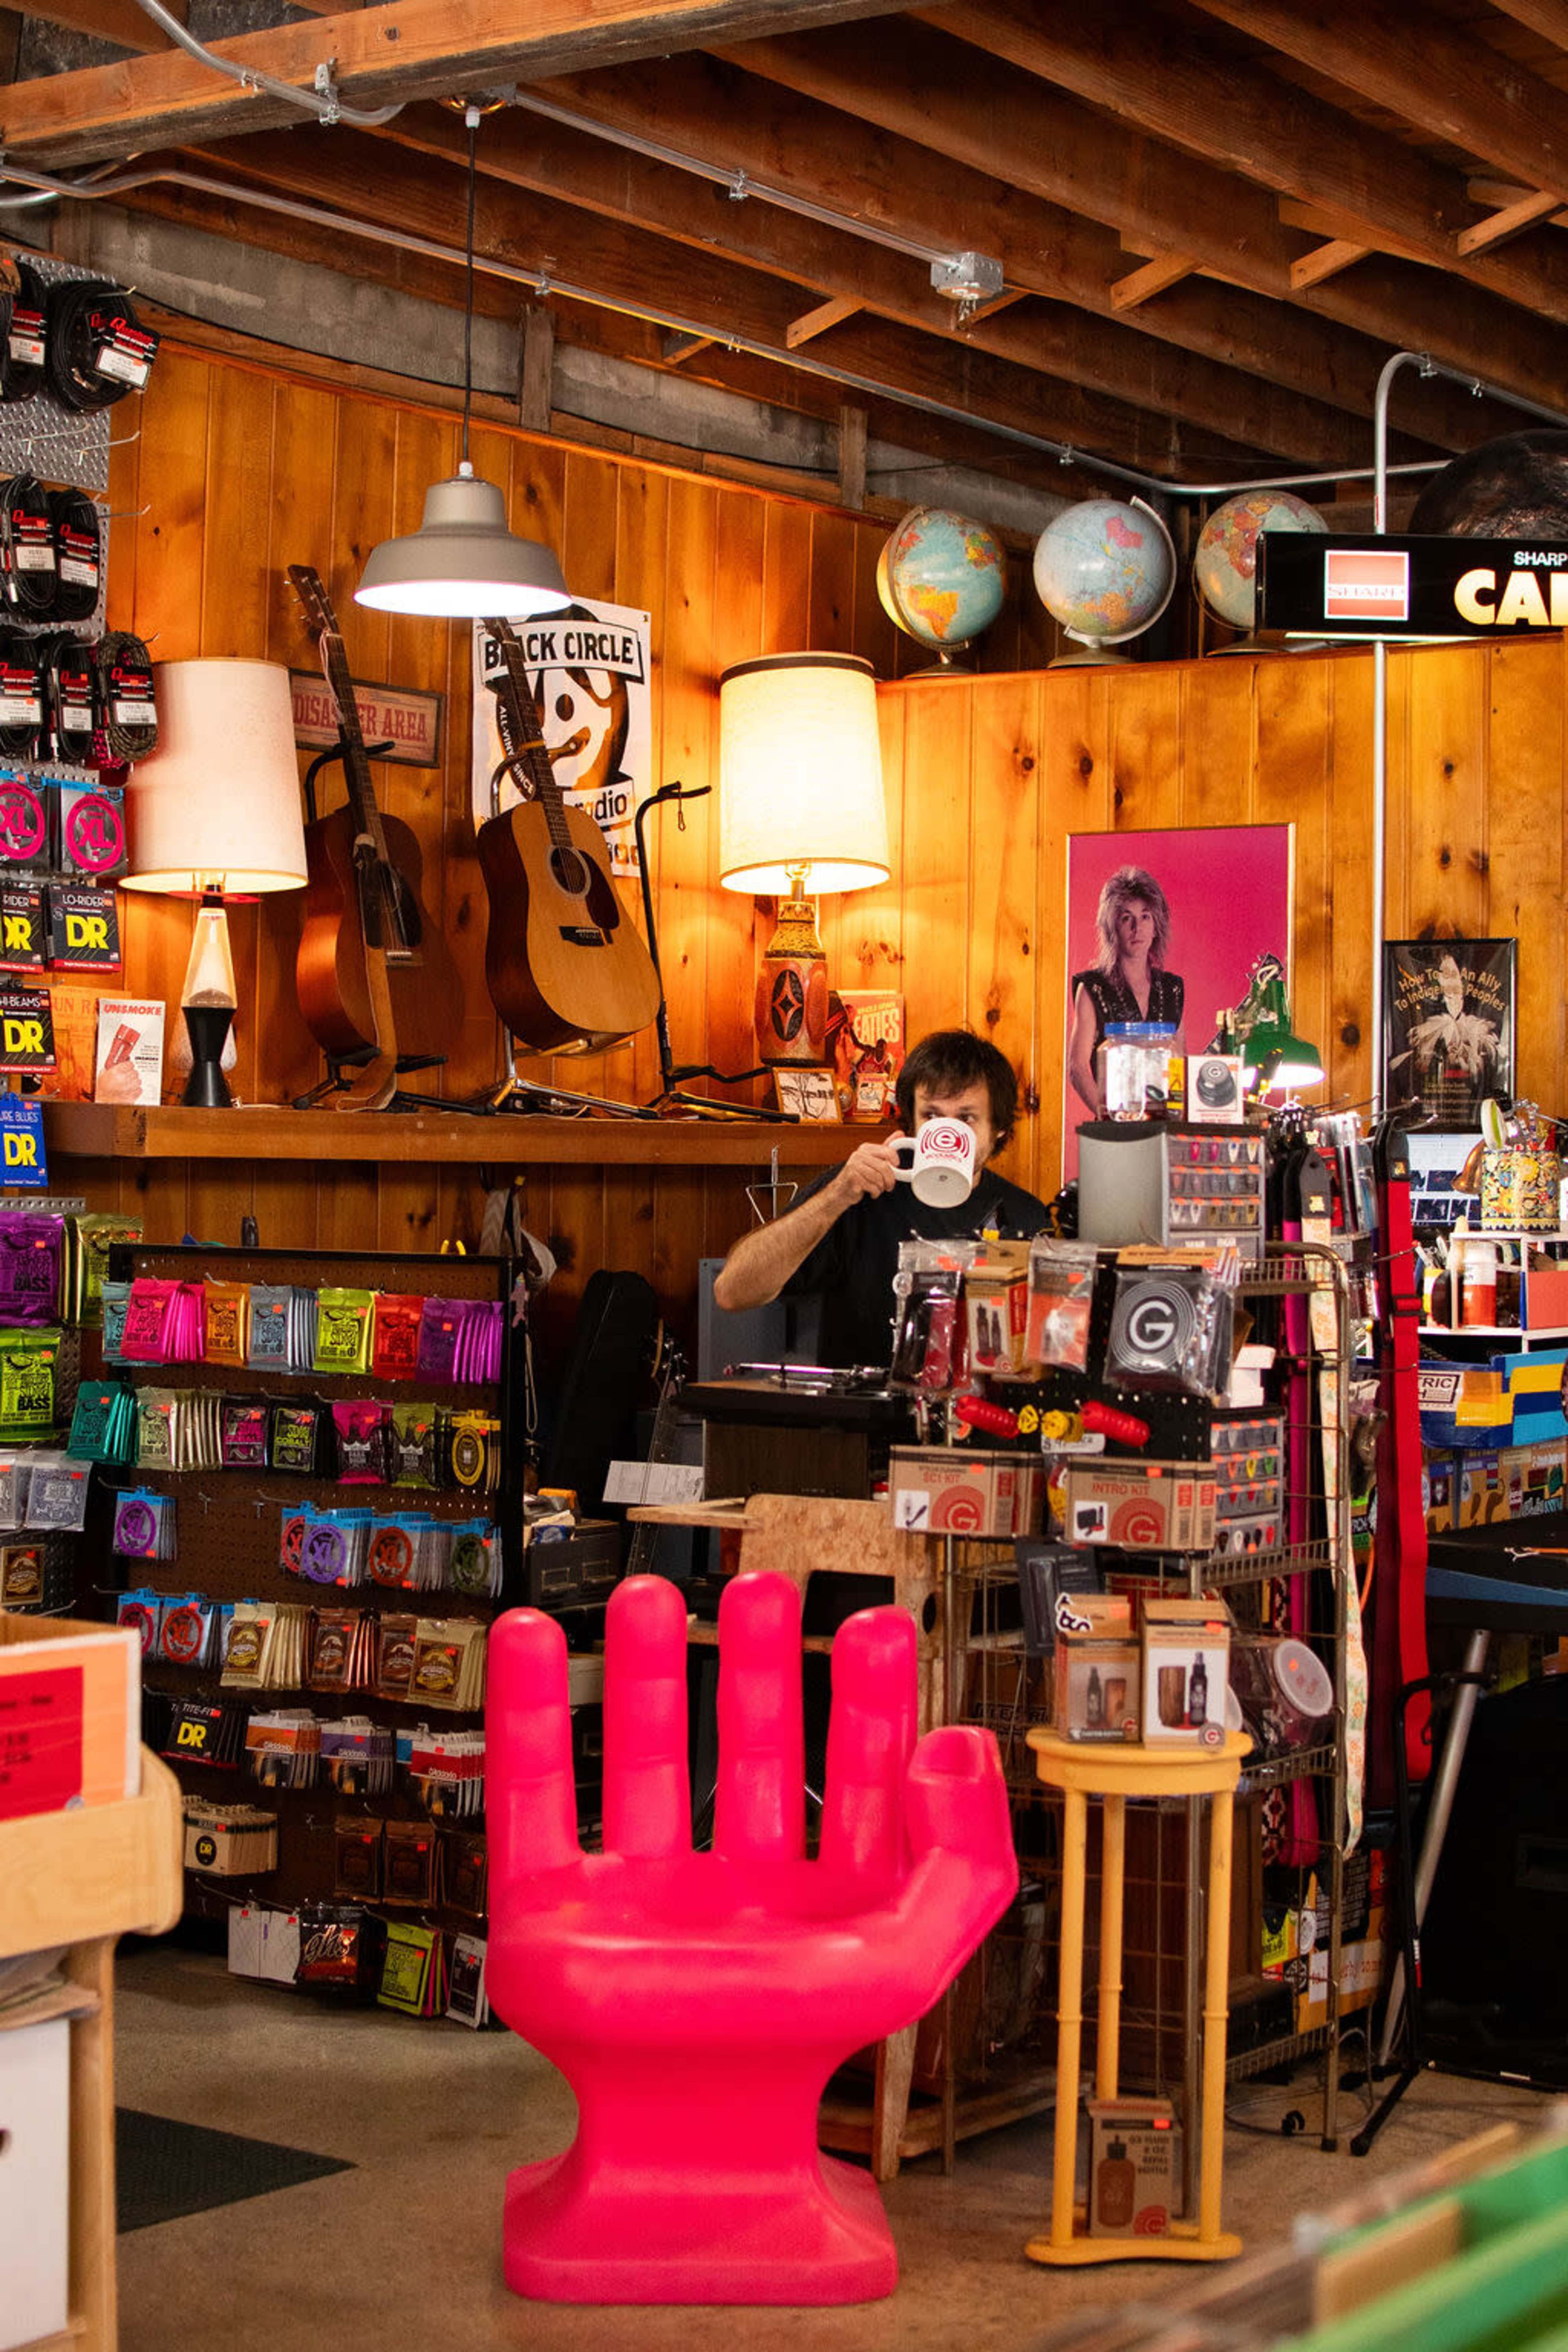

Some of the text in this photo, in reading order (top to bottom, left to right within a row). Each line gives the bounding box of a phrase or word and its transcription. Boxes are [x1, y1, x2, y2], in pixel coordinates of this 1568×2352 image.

[1514, 551, 1568, 566] SHARP
[564, 632, 634, 664] CIRCLE
[381, 708, 428, 742] AREA
[513, 763, 535, 795] SINCE
[66, 914, 109, 950] DR
[1460, 967, 1476, 980] An
[1478, 971, 1502, 993] Ally
[103, 1003, 162, 1016] UNSMOKE
[1394, 999, 1408, 1012] To
[1466, 983, 1506, 1012] Peoples
[4, 1020, 45, 1054] DR
[3, 1133, 37, 1167] DR
[17, 1395, 51, 1410] BASS
[176, 1722, 207, 1748] DR
